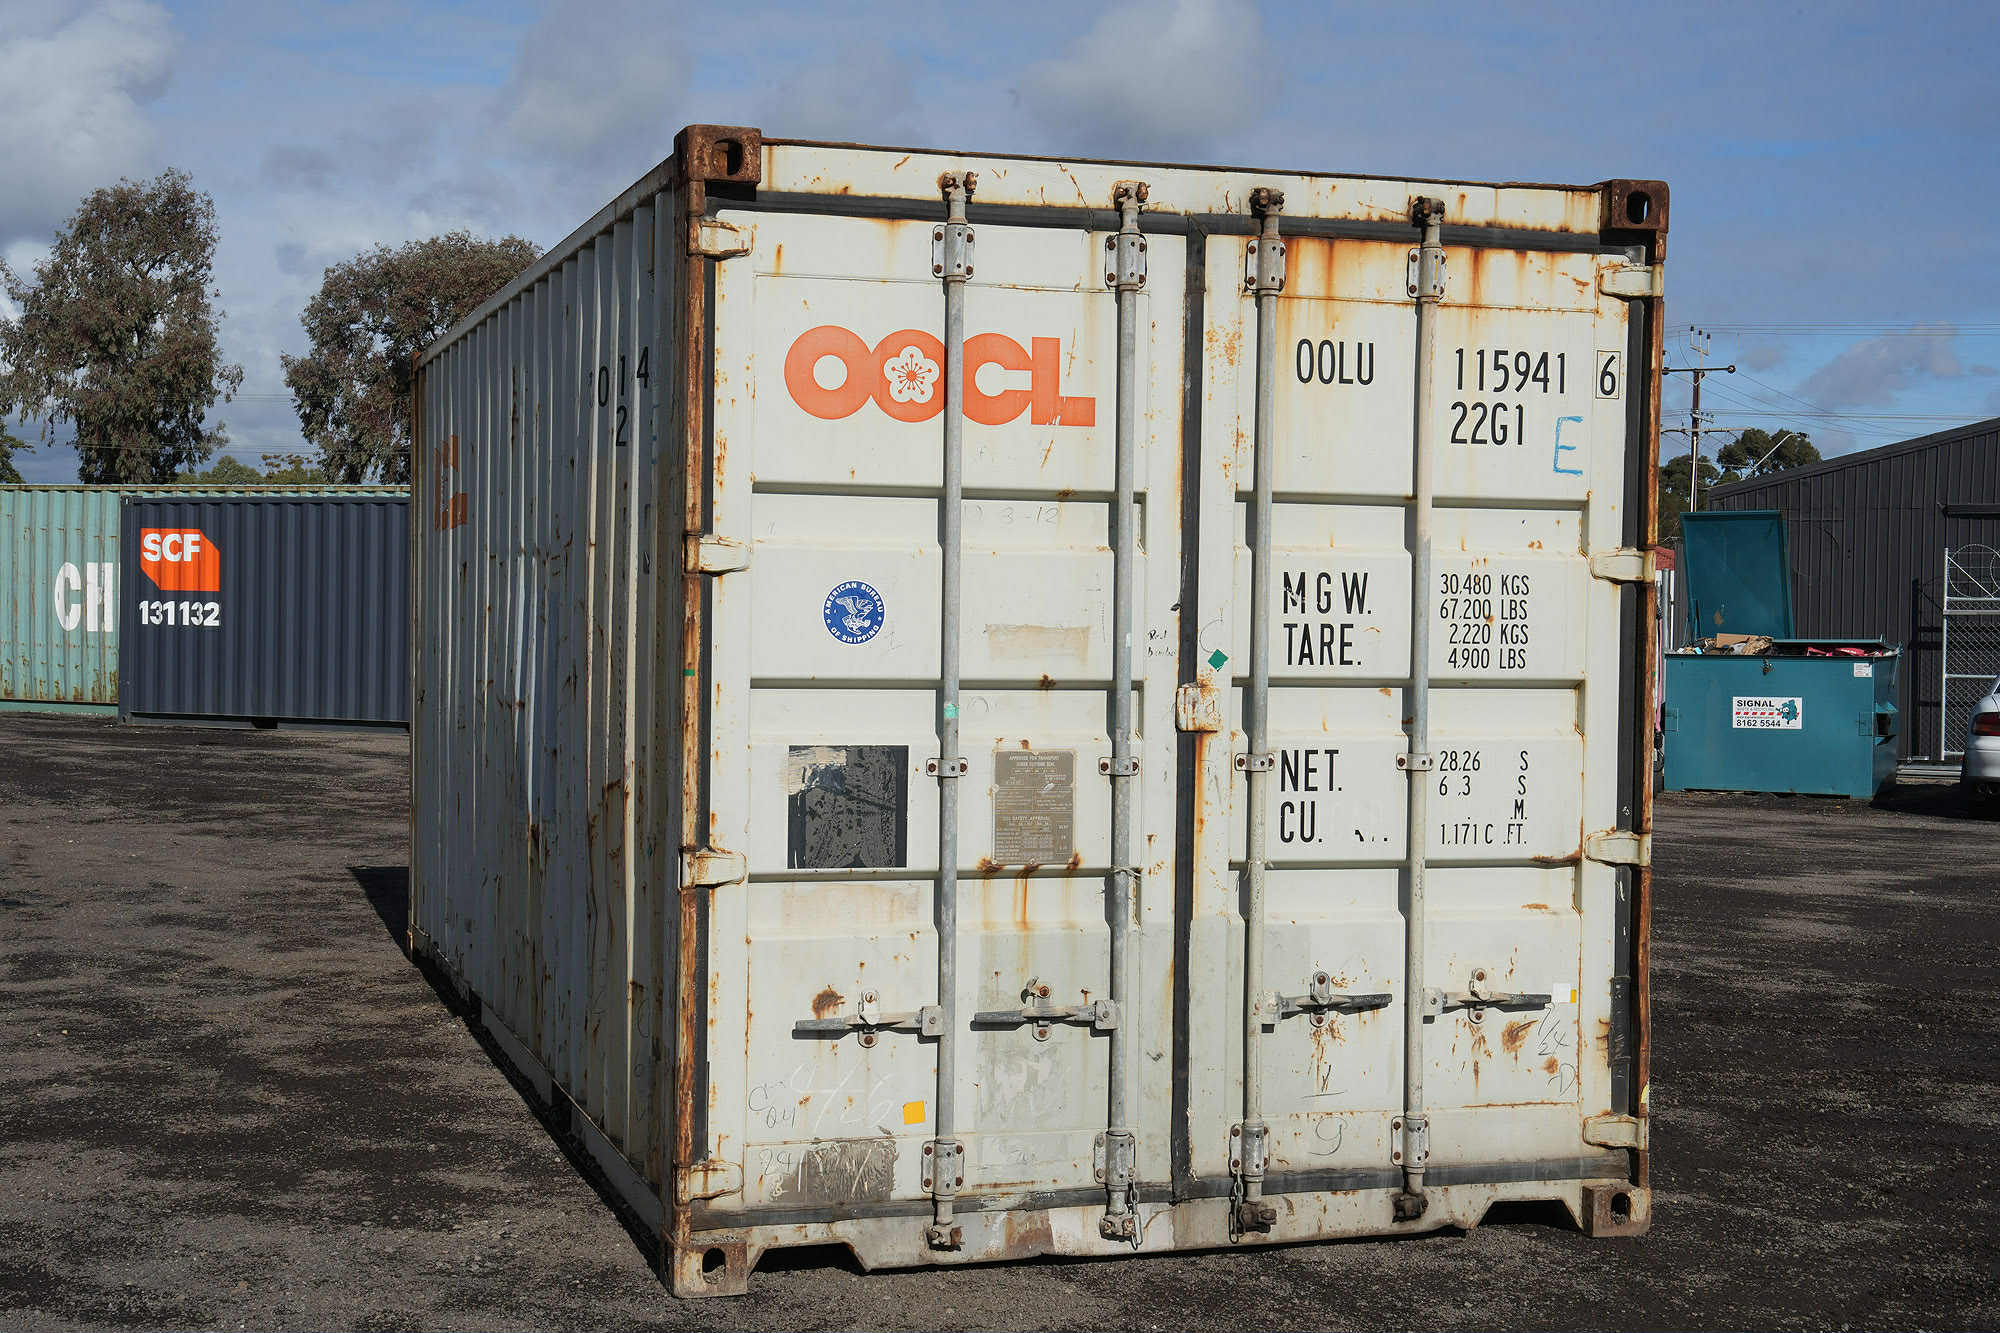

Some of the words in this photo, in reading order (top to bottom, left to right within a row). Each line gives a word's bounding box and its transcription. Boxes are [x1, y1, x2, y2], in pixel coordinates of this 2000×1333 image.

[784, 325, 1096, 427] OOCL
[1296, 338, 1375, 385] OOLU
[1455, 347, 1566, 394] 115941
[1598, 354, 1617, 396] 6
[1450, 401, 1525, 446] 22G1
[1553, 415, 1584, 475] E
[143, 533, 201, 562] SCF
[55, 562, 120, 632] CH
[824, 582, 857, 615] AMERICAN
[861, 583, 884, 613] BUREAU
[1440, 573, 1492, 595] 30,480
[1501, 574, 1530, 596] KGS
[1440, 598, 1493, 620] 67,200
[1501, 599, 1528, 620] LBS
[830, 626, 842, 638] OF
[841, 624, 880, 643] SHIPPING
[1283, 623, 1362, 666] TARE.
[1449, 623, 1491, 645] 2,220
[1500, 623, 1529, 645] KGS
[1447, 647, 1490, 669] 4,900
[1499, 648, 1527, 669] LBS
[1736, 699, 1775, 707] SIGNAL
[1736, 719, 1757, 727] 8162
[1760, 719, 1781, 728] 5544
[1280, 749, 1343, 792] NET.
[1280, 800, 1323, 843] CU.
